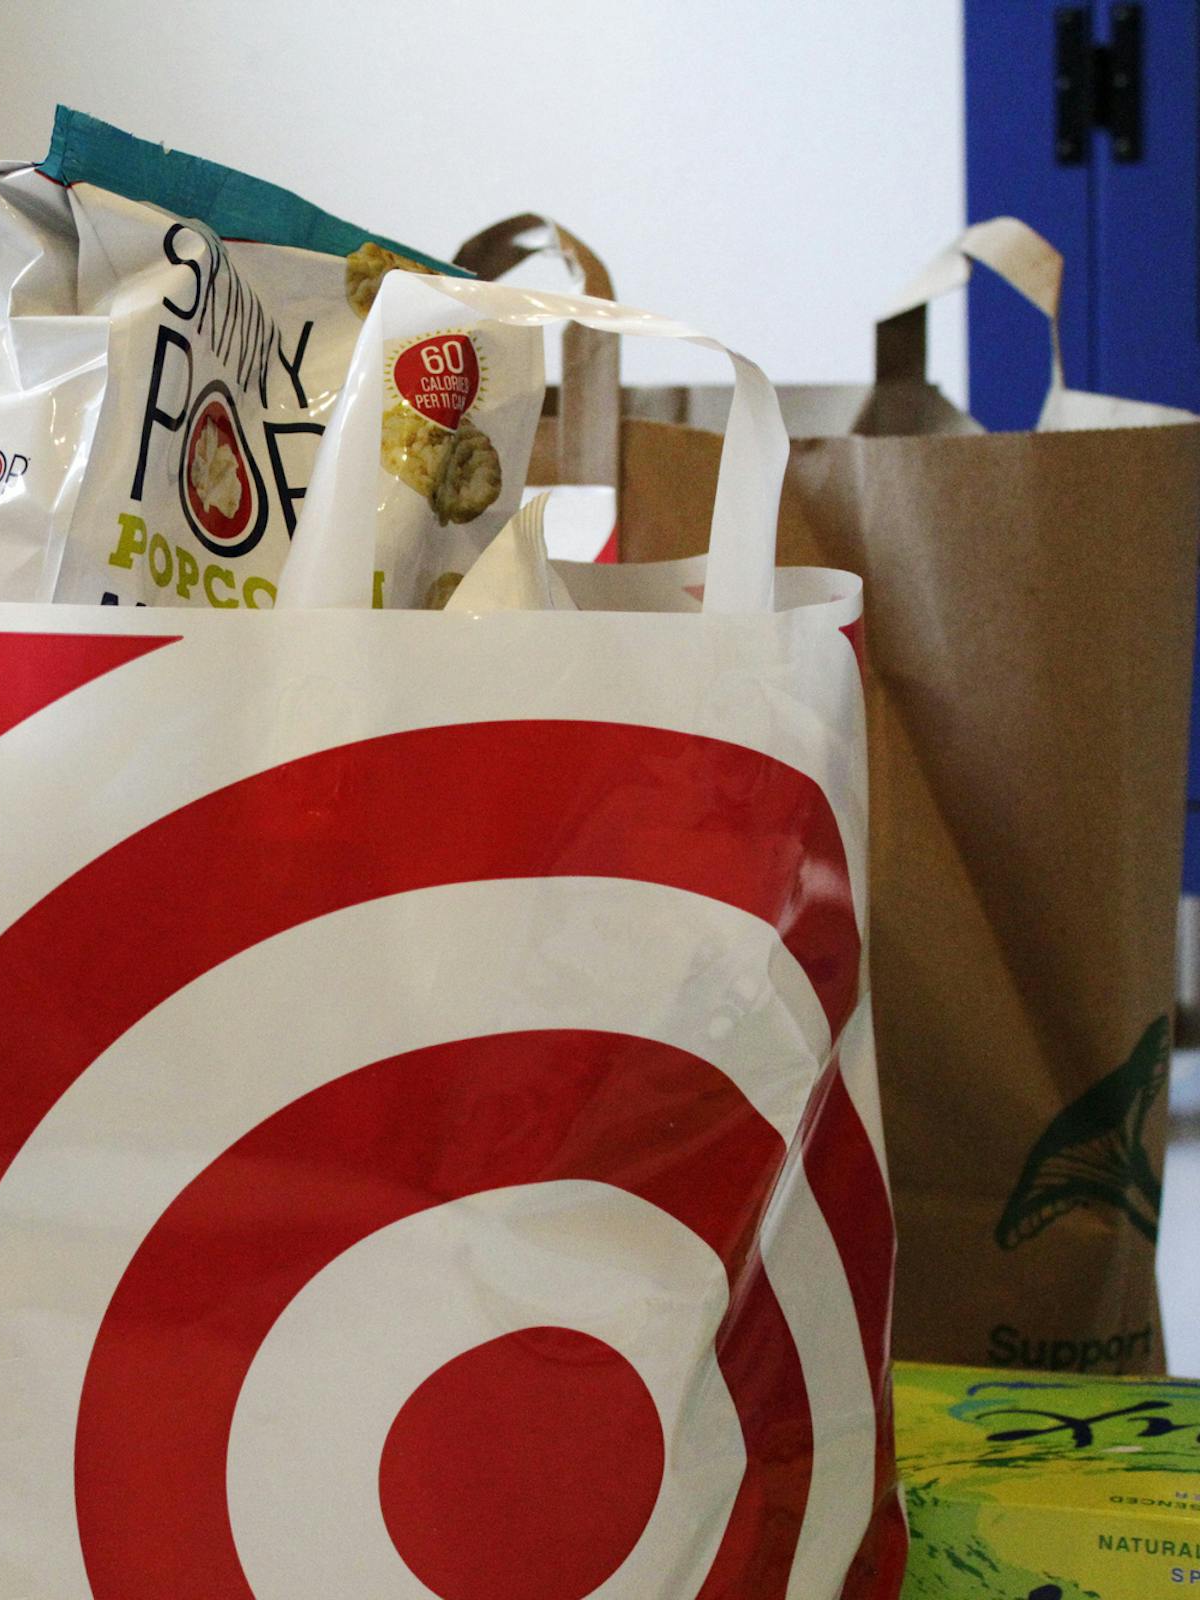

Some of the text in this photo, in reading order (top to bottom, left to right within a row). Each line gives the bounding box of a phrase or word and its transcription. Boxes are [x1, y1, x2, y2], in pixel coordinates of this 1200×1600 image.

[163, 223, 314, 409] SKINNY
[421, 341, 464, 374] 60
[415, 393, 440, 409] PER
[420, 375, 470, 394] CALORIES
[989, 1324, 1154, 1372] Support
